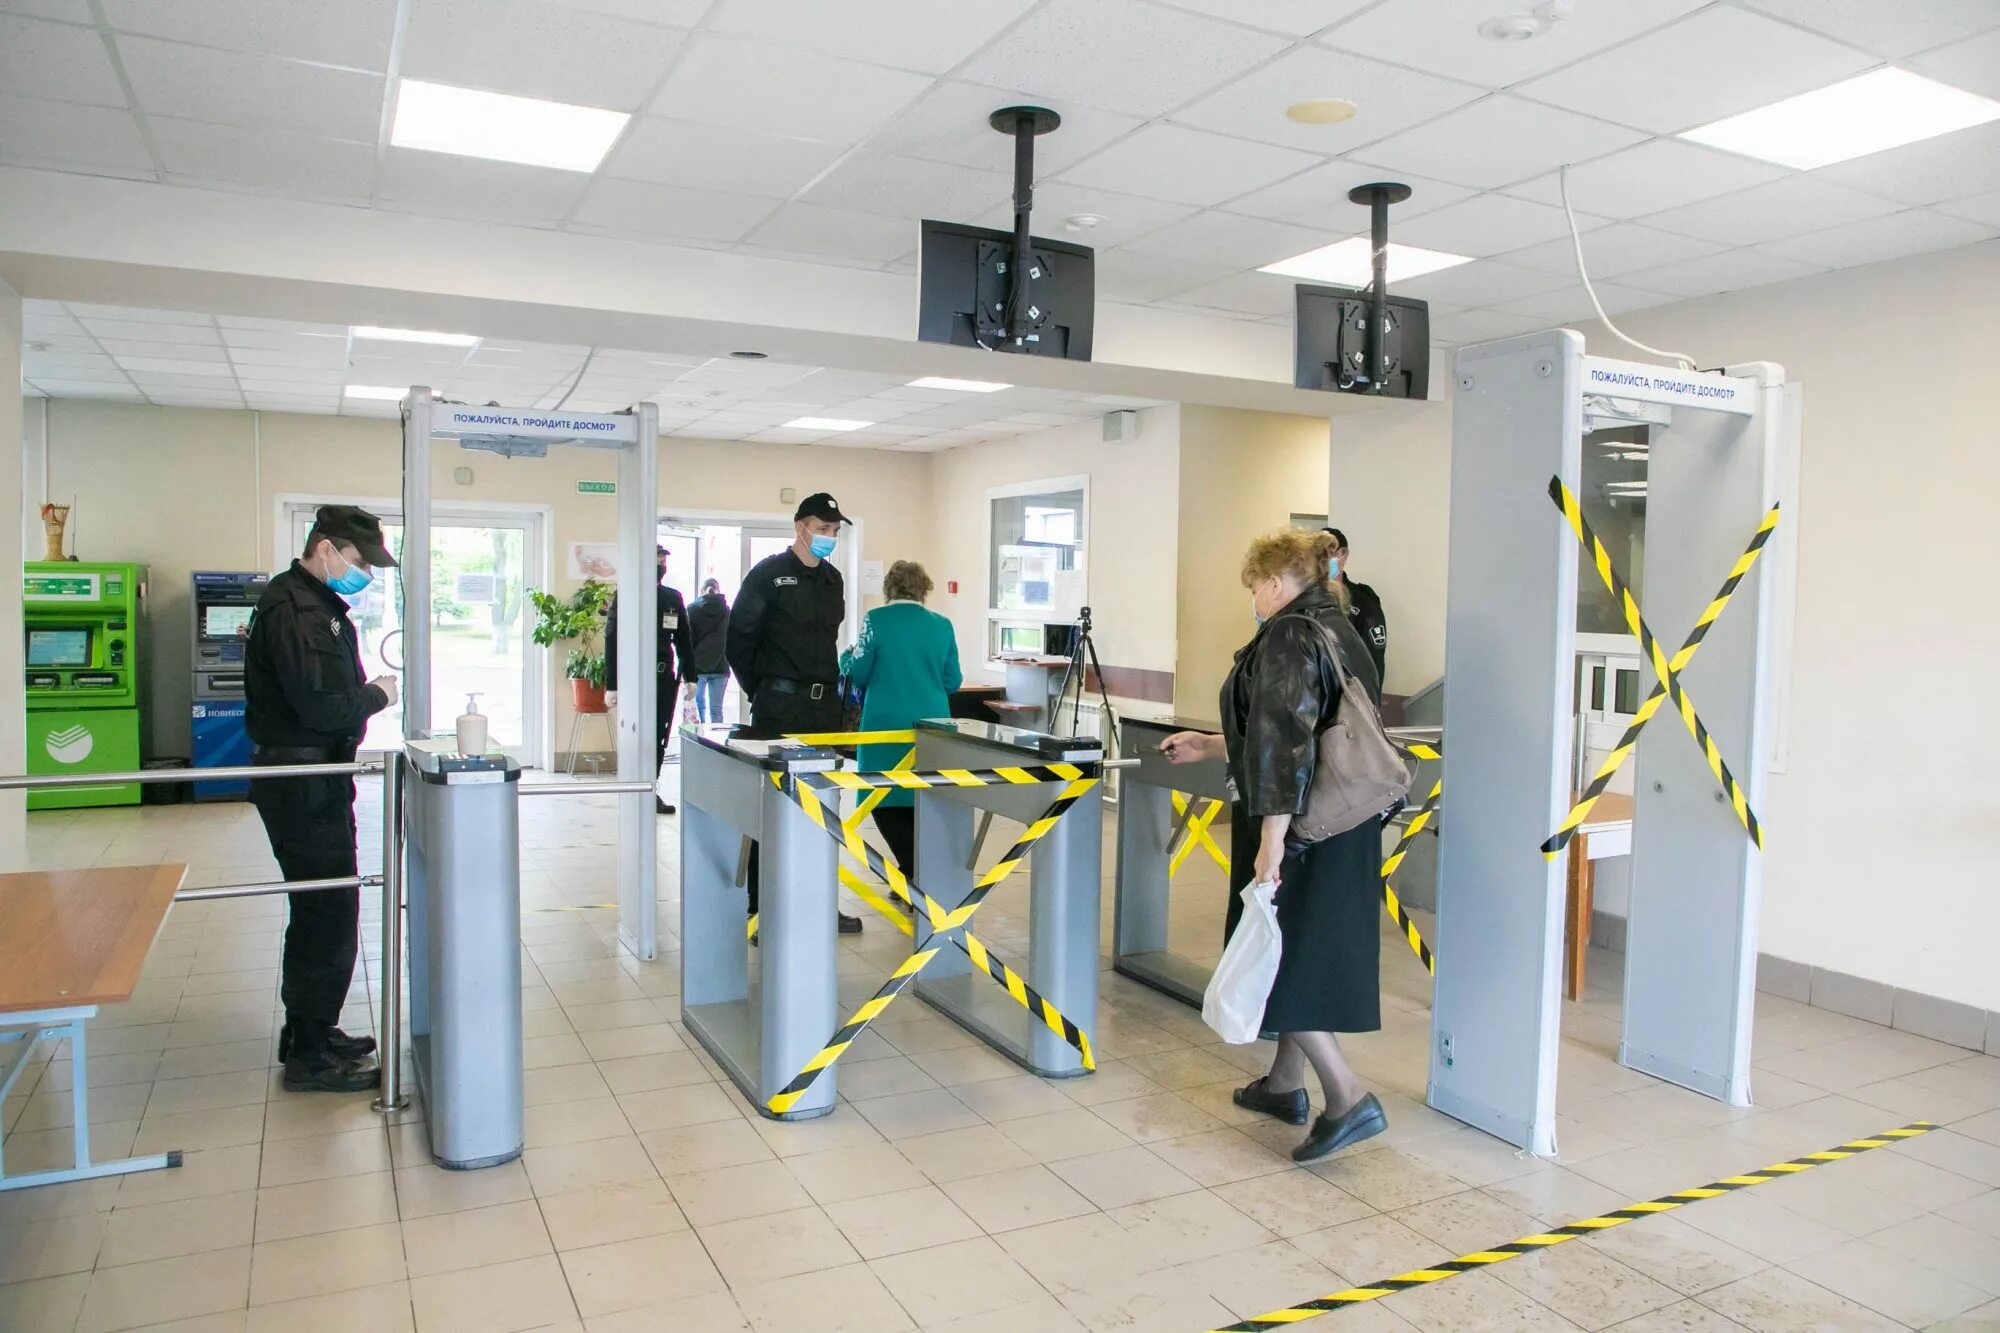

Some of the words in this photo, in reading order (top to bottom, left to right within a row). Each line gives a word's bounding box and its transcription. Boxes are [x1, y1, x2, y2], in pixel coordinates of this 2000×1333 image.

[1592, 370, 1651, 389] ПОЖАЛУЙСТА,
[1653, 379, 1696, 394] ПРОЙДИТЕ
[1698, 386, 1735, 400] ДОСМОТР
[454, 414, 520, 426] ПОЖАЛУЙСТА,
[523, 418, 571, 429] ПРОЙДИТЕ
[573, 421, 616, 432] ДОСМОТР
